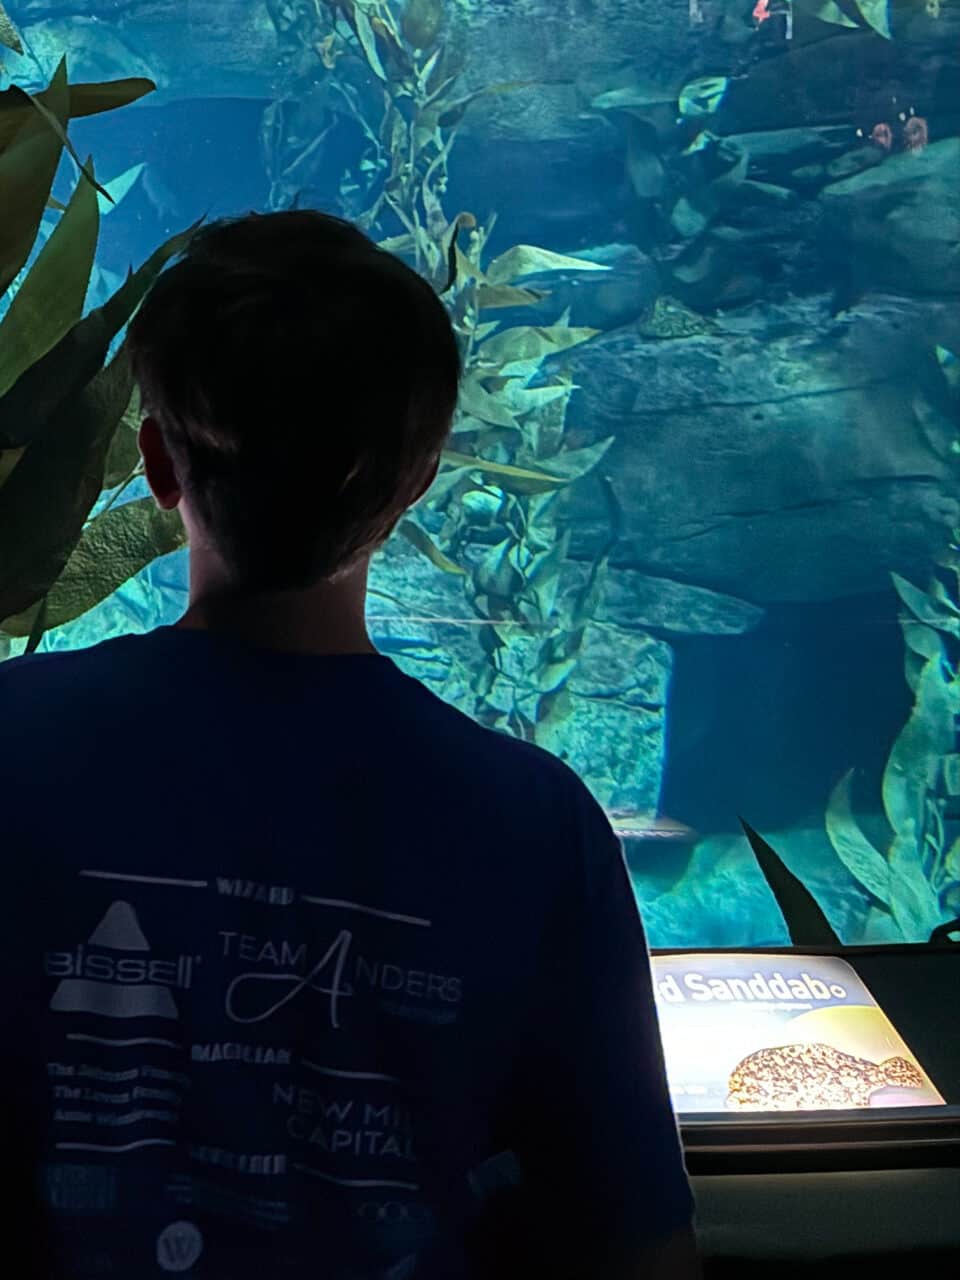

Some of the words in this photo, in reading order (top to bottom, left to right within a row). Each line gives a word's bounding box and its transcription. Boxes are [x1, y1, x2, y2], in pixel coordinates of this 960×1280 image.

[217, 930, 308, 966] TEAM
[684, 972, 835, 1001] Sanddab
[272, 1081, 353, 1124] NEW
